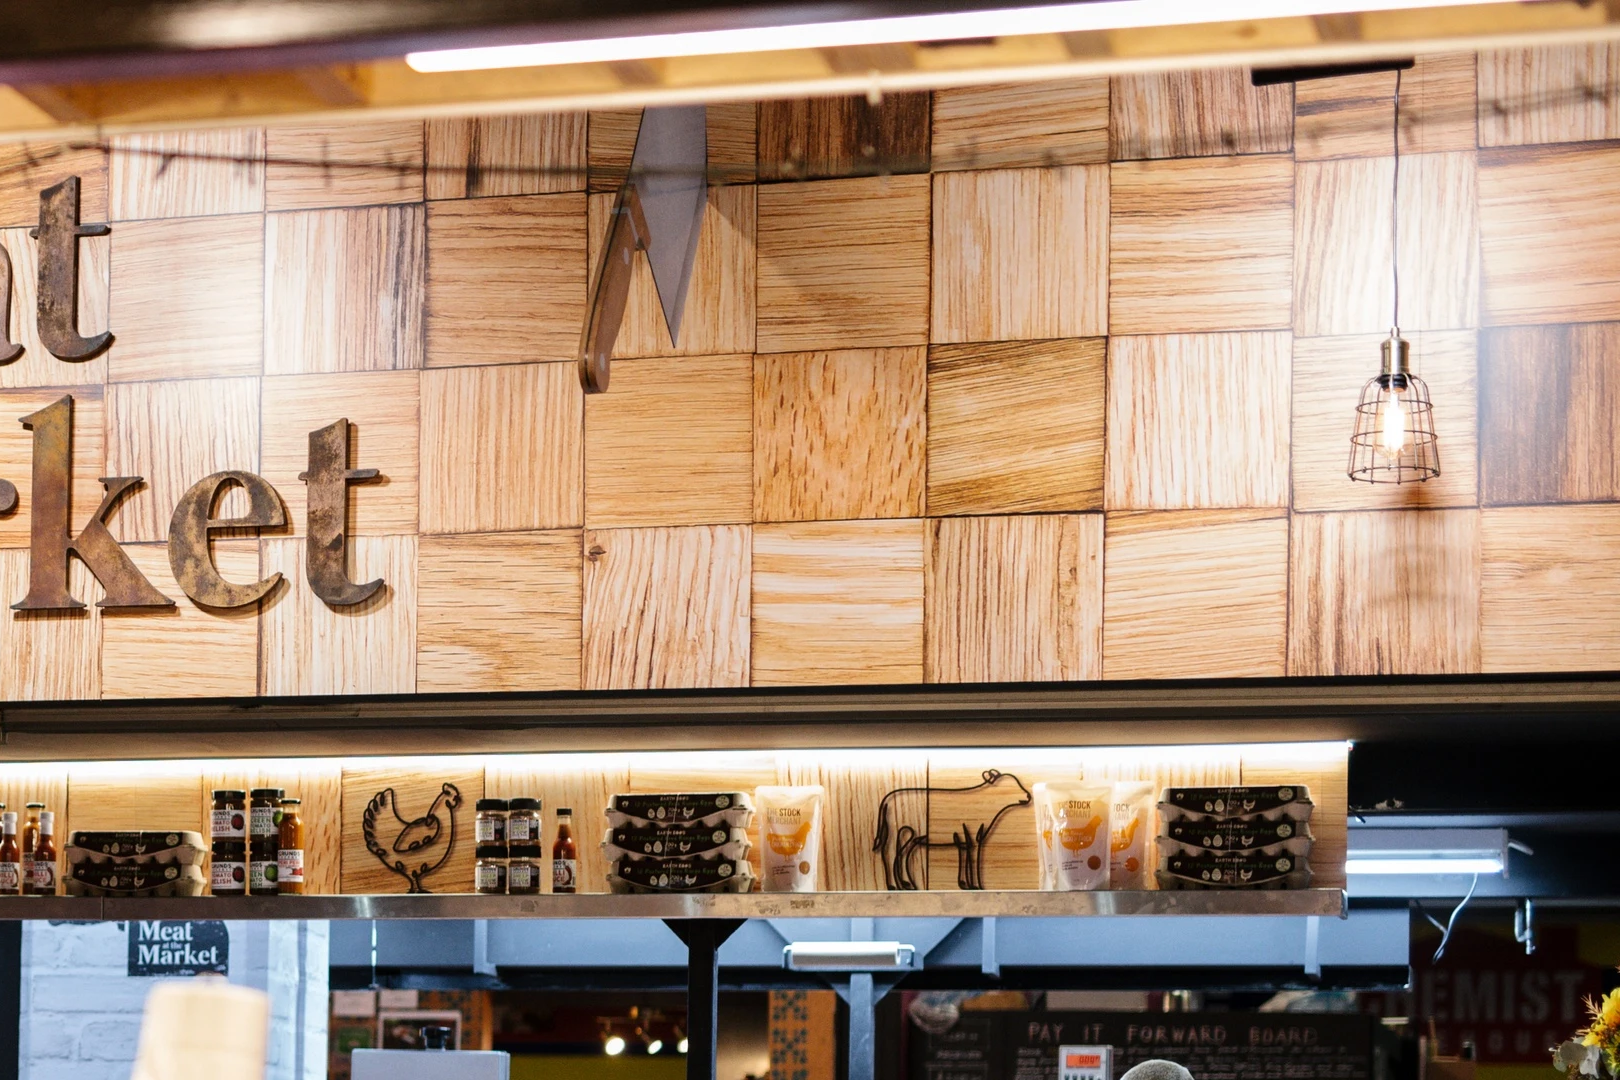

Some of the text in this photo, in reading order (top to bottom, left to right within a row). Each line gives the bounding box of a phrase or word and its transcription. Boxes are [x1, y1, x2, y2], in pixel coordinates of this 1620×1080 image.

[779, 808, 801, 817] STOCK
[1068, 800, 1091, 809] STOCK
[1113, 803, 1130, 812] TOCK
[137, 920, 193, 941] Meat
[137, 943, 219, 965] Market
[1384, 968, 1585, 1024] EMIST
[1028, 1022, 1319, 1046] PAY IT FORWARD BOARD
